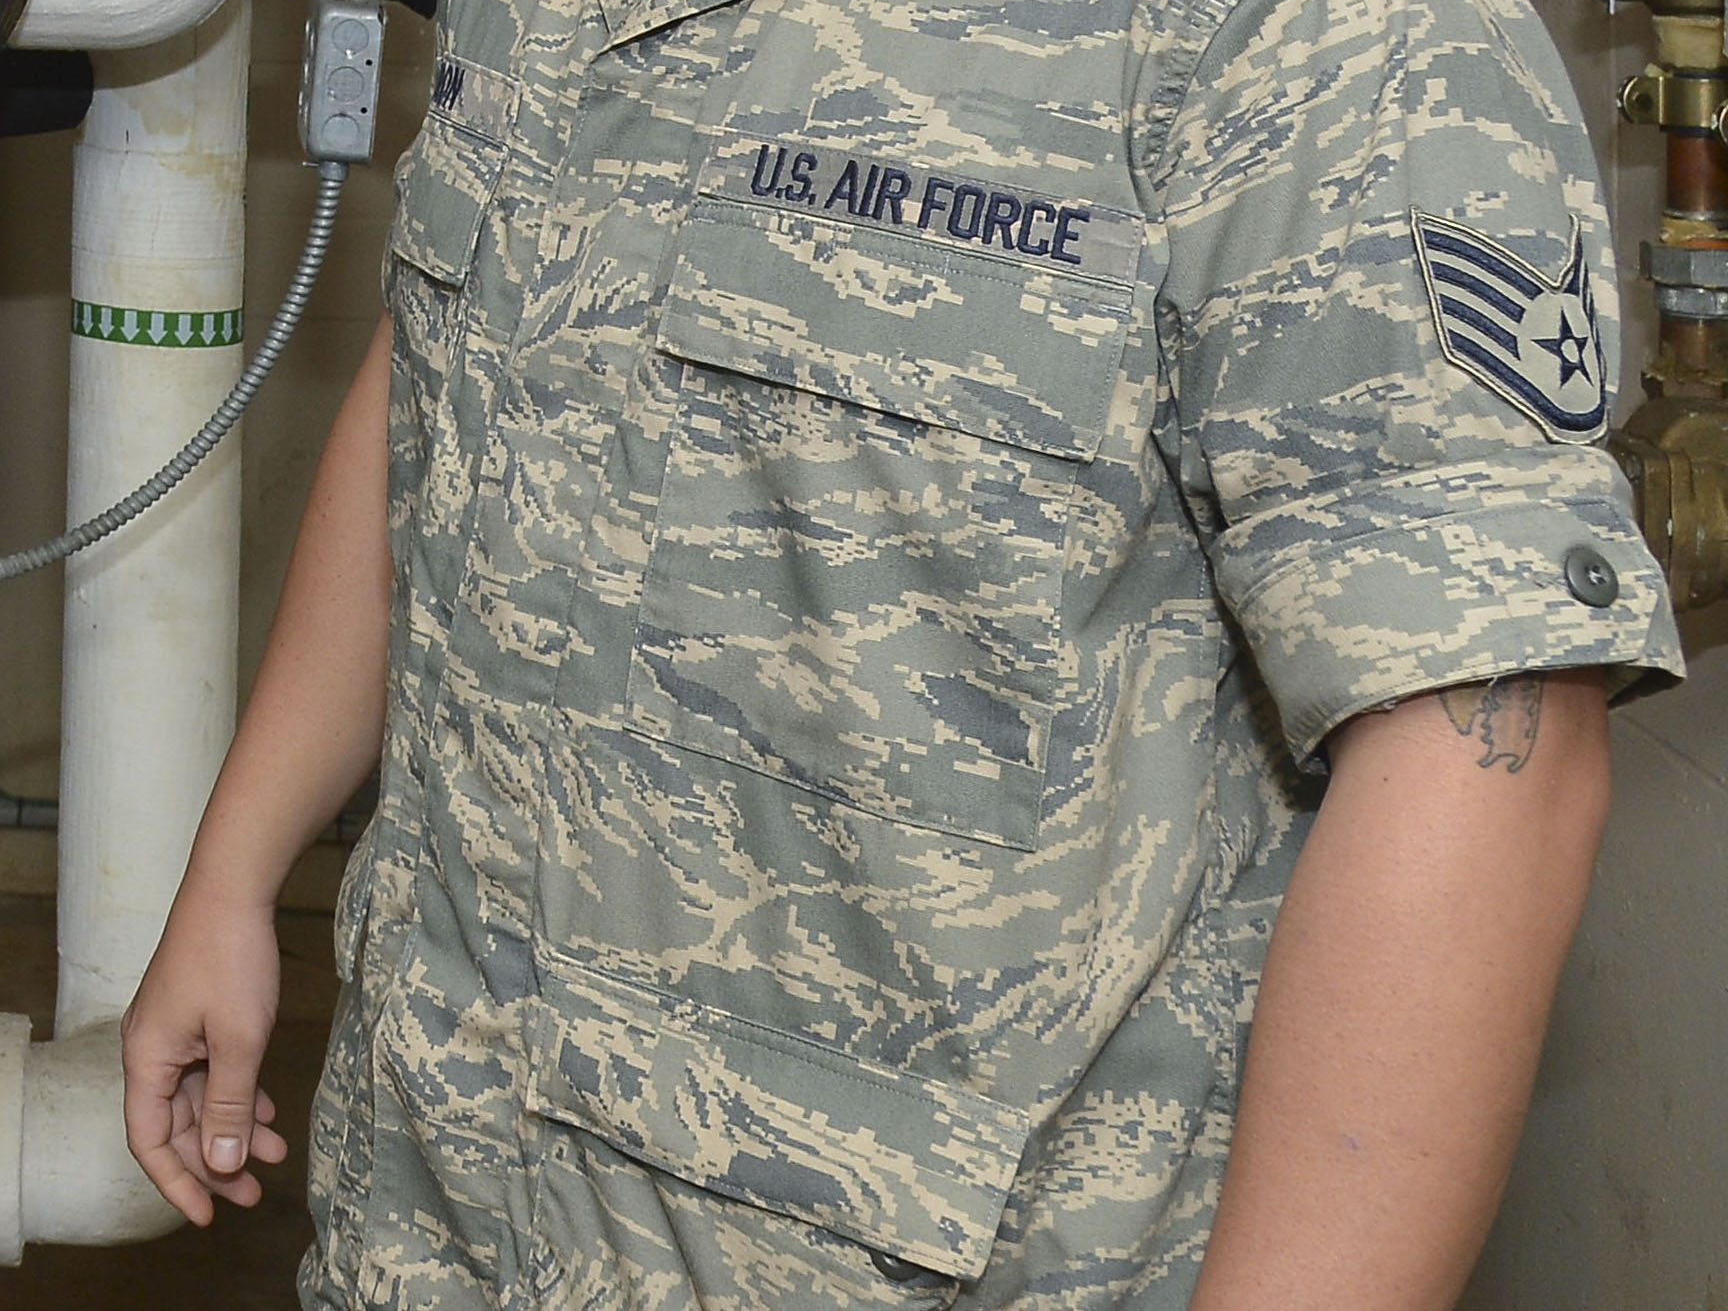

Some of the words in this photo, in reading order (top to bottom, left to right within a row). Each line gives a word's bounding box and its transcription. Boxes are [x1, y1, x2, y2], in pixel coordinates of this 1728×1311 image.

[751, 144, 818, 206] U.S.
[824, 159, 912, 225] AIR
[918, 176, 1091, 265] FORCE
